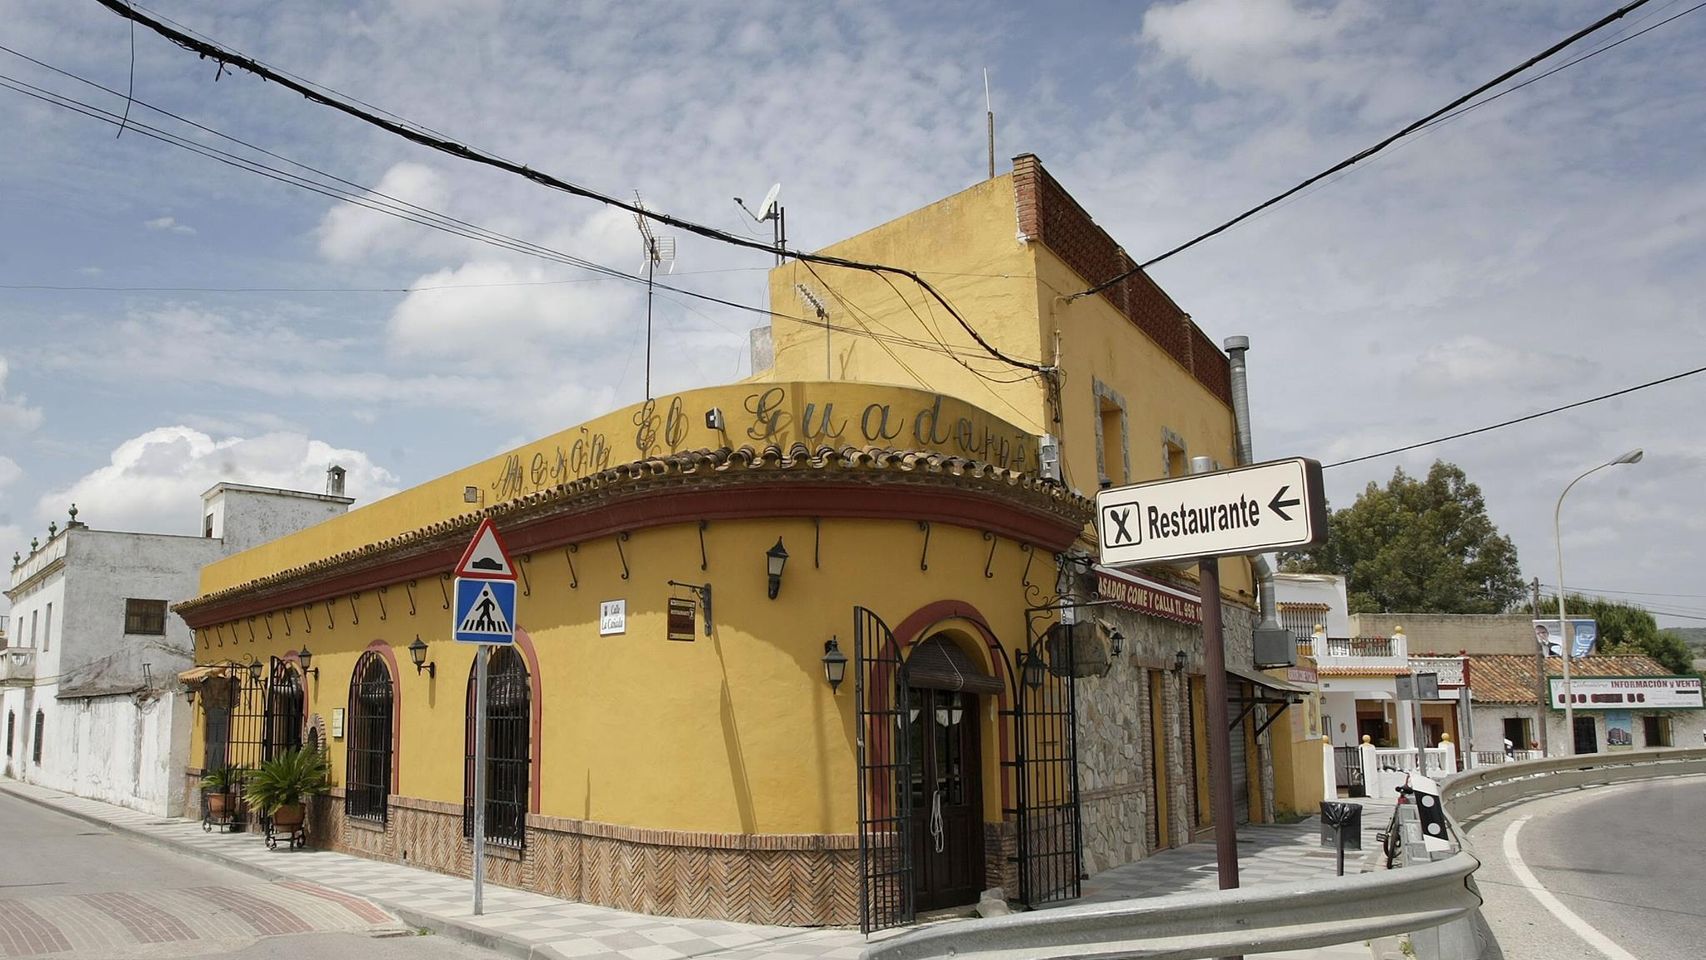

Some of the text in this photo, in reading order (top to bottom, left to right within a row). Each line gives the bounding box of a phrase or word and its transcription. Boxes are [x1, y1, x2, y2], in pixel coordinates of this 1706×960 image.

[634, 396, 684, 450] El
[1147, 493, 1260, 540] Restaurante
[1098, 576, 1127, 602] ASADOR
[1127, 586, 1148, 607] COME
[1149, 592, 1154, 609] Y
[1154, 594, 1175, 614] CALLA
[1611, 679, 1668, 689] INFORMACIÓN
[1675, 680, 1702, 688] VENTA
